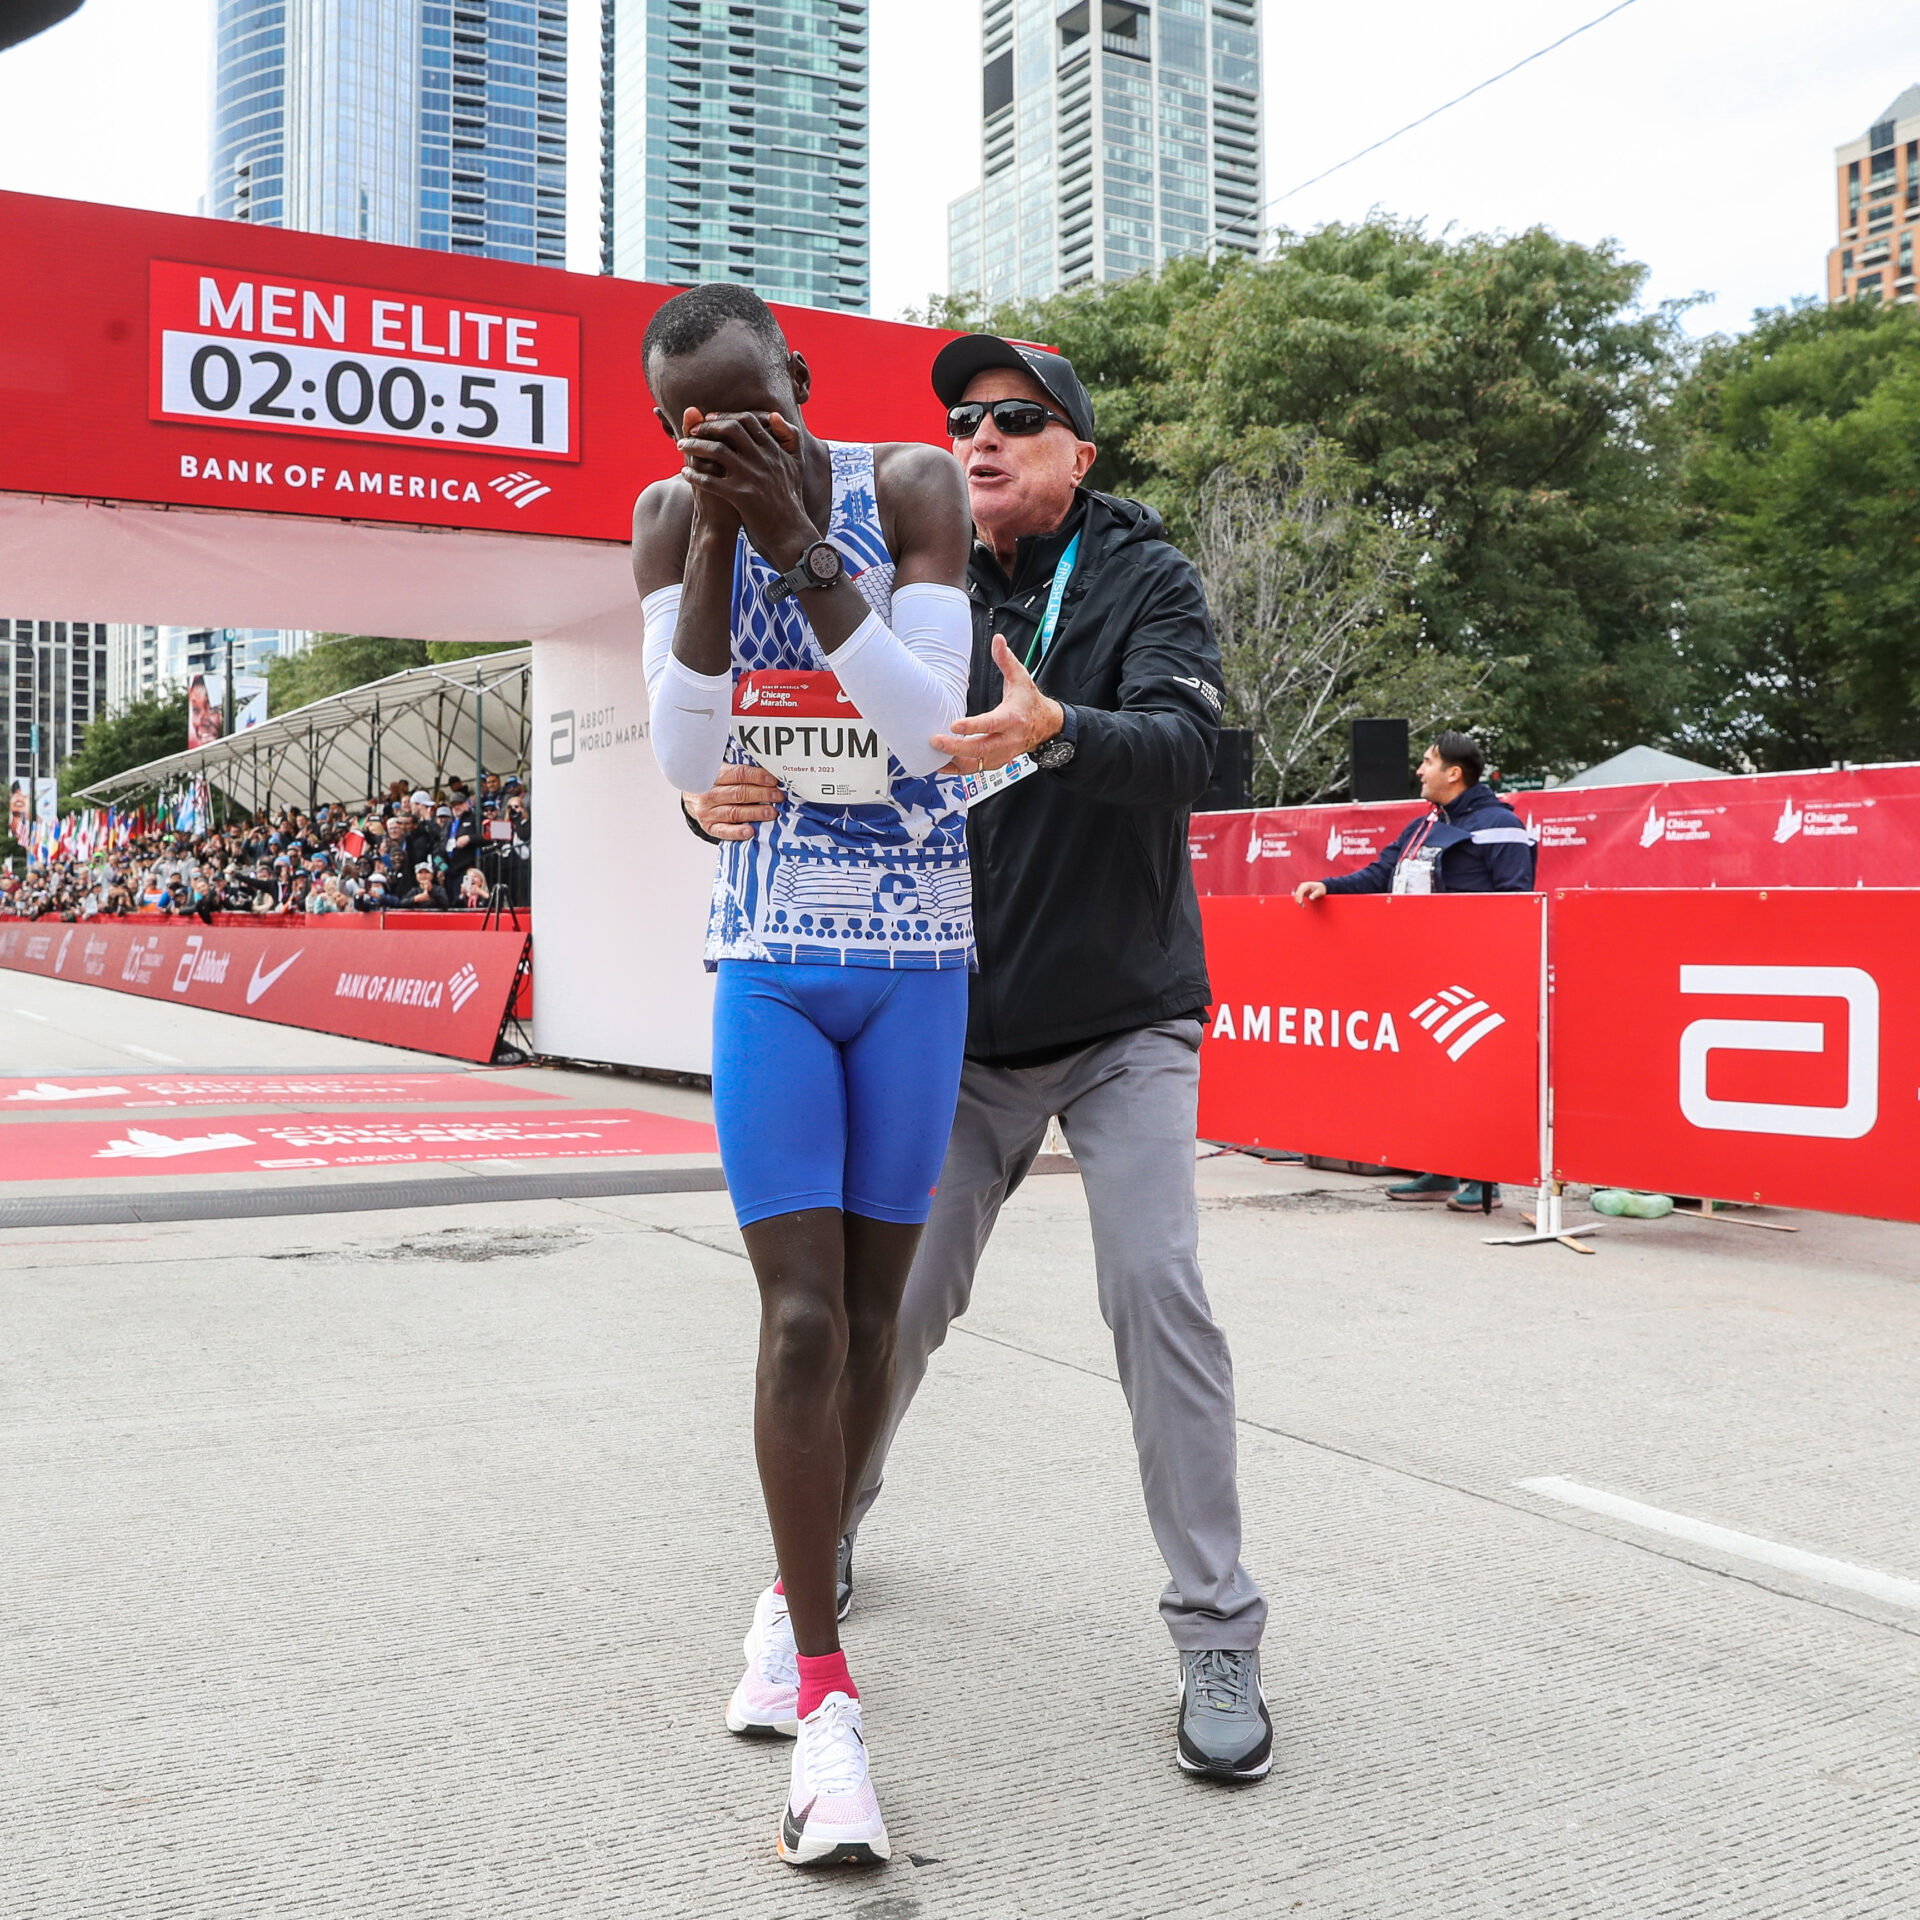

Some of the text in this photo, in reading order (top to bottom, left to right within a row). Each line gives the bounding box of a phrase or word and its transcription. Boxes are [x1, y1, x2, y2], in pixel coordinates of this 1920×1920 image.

[199, 276, 538, 367] MEN ELITE
[190, 344, 544, 445] 02:00:51
[180, 455, 481, 503] BANK OF AMERICA
[1051, 561, 1071, 600] FINISH
[1043, 603, 1060, 633] LINE
[760, 699, 798, 707] Marathon
[761, 691, 791, 700] Chicago
[580, 706, 615, 730] ABBOTT
[580, 731, 612, 752] WORLD
[738, 725, 878, 758] KIPTUM
[1666, 818, 1703, 831] Chicago
[1803, 812, 1848, 826] Chicago
[1542, 825, 1577, 838] Chicago
[1665, 830, 1711, 841] Marathon
[1803, 824, 1858, 836] Marathon
[1342, 836, 1371, 848] Chicago
[1542, 836, 1587, 847] Marathon
[1342, 846, 1377, 856] Marathon
[335, 972, 444, 1009] BANK OF AMERICA
[1212, 1003, 1400, 1053] AMERICA
[271, 1128, 521, 1140] Chicago
[285, 1131, 603, 1147] Marathon
